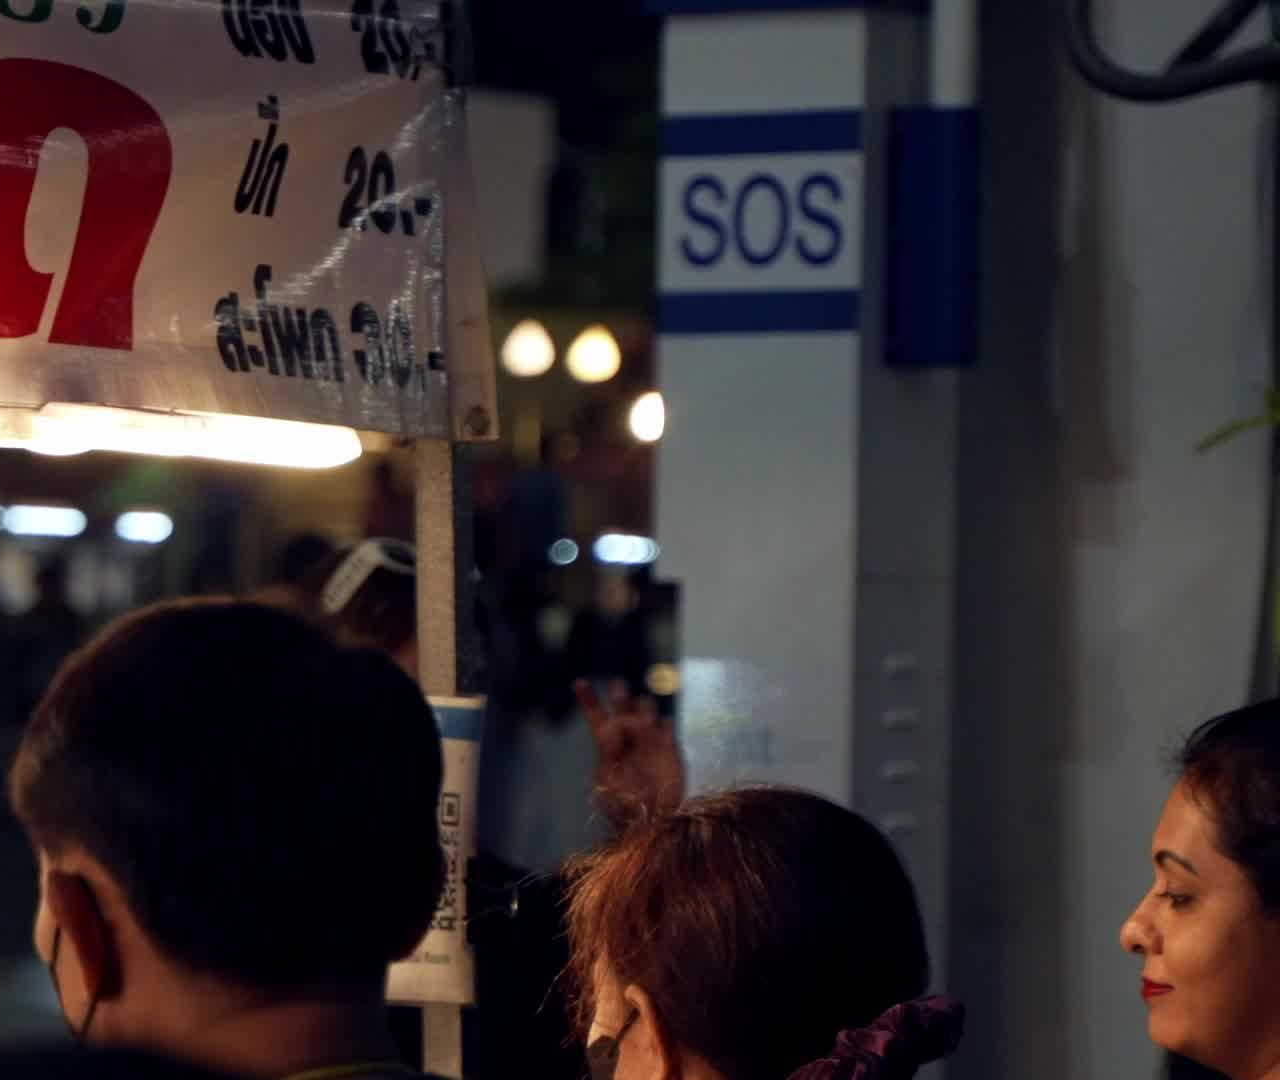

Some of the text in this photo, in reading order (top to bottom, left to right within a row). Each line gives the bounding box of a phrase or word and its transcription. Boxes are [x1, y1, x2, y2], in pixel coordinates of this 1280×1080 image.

[234, 95, 289, 217] ปีก
[680, 172, 842, 267] SOS
[215, 264, 344, 382] สะโพก
